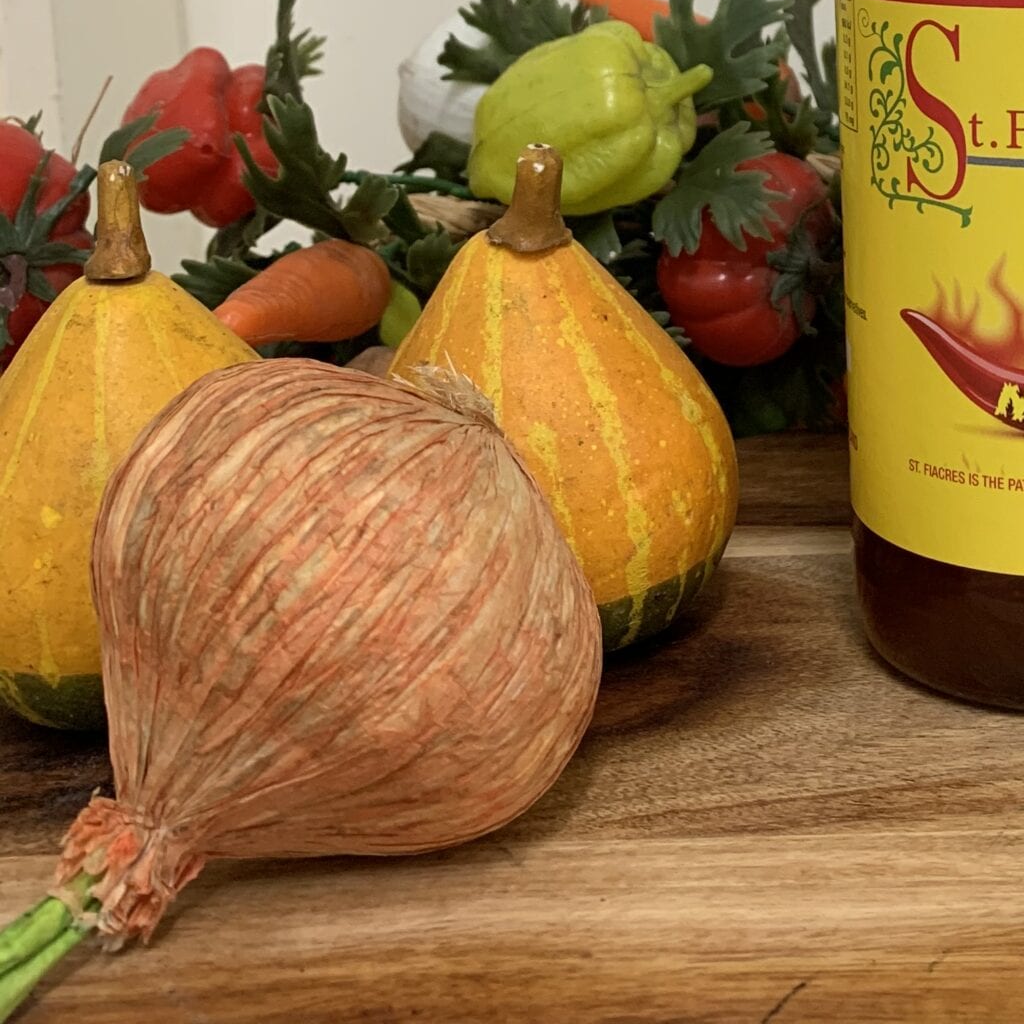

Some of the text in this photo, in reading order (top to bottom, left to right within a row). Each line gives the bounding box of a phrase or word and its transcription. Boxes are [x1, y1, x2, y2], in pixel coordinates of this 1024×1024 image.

[908, 458, 921, 473] ST.
[923, 463, 965, 484] FIACRES
[968, 473, 979, 487] IS
[982, 475, 1005, 490] THE
